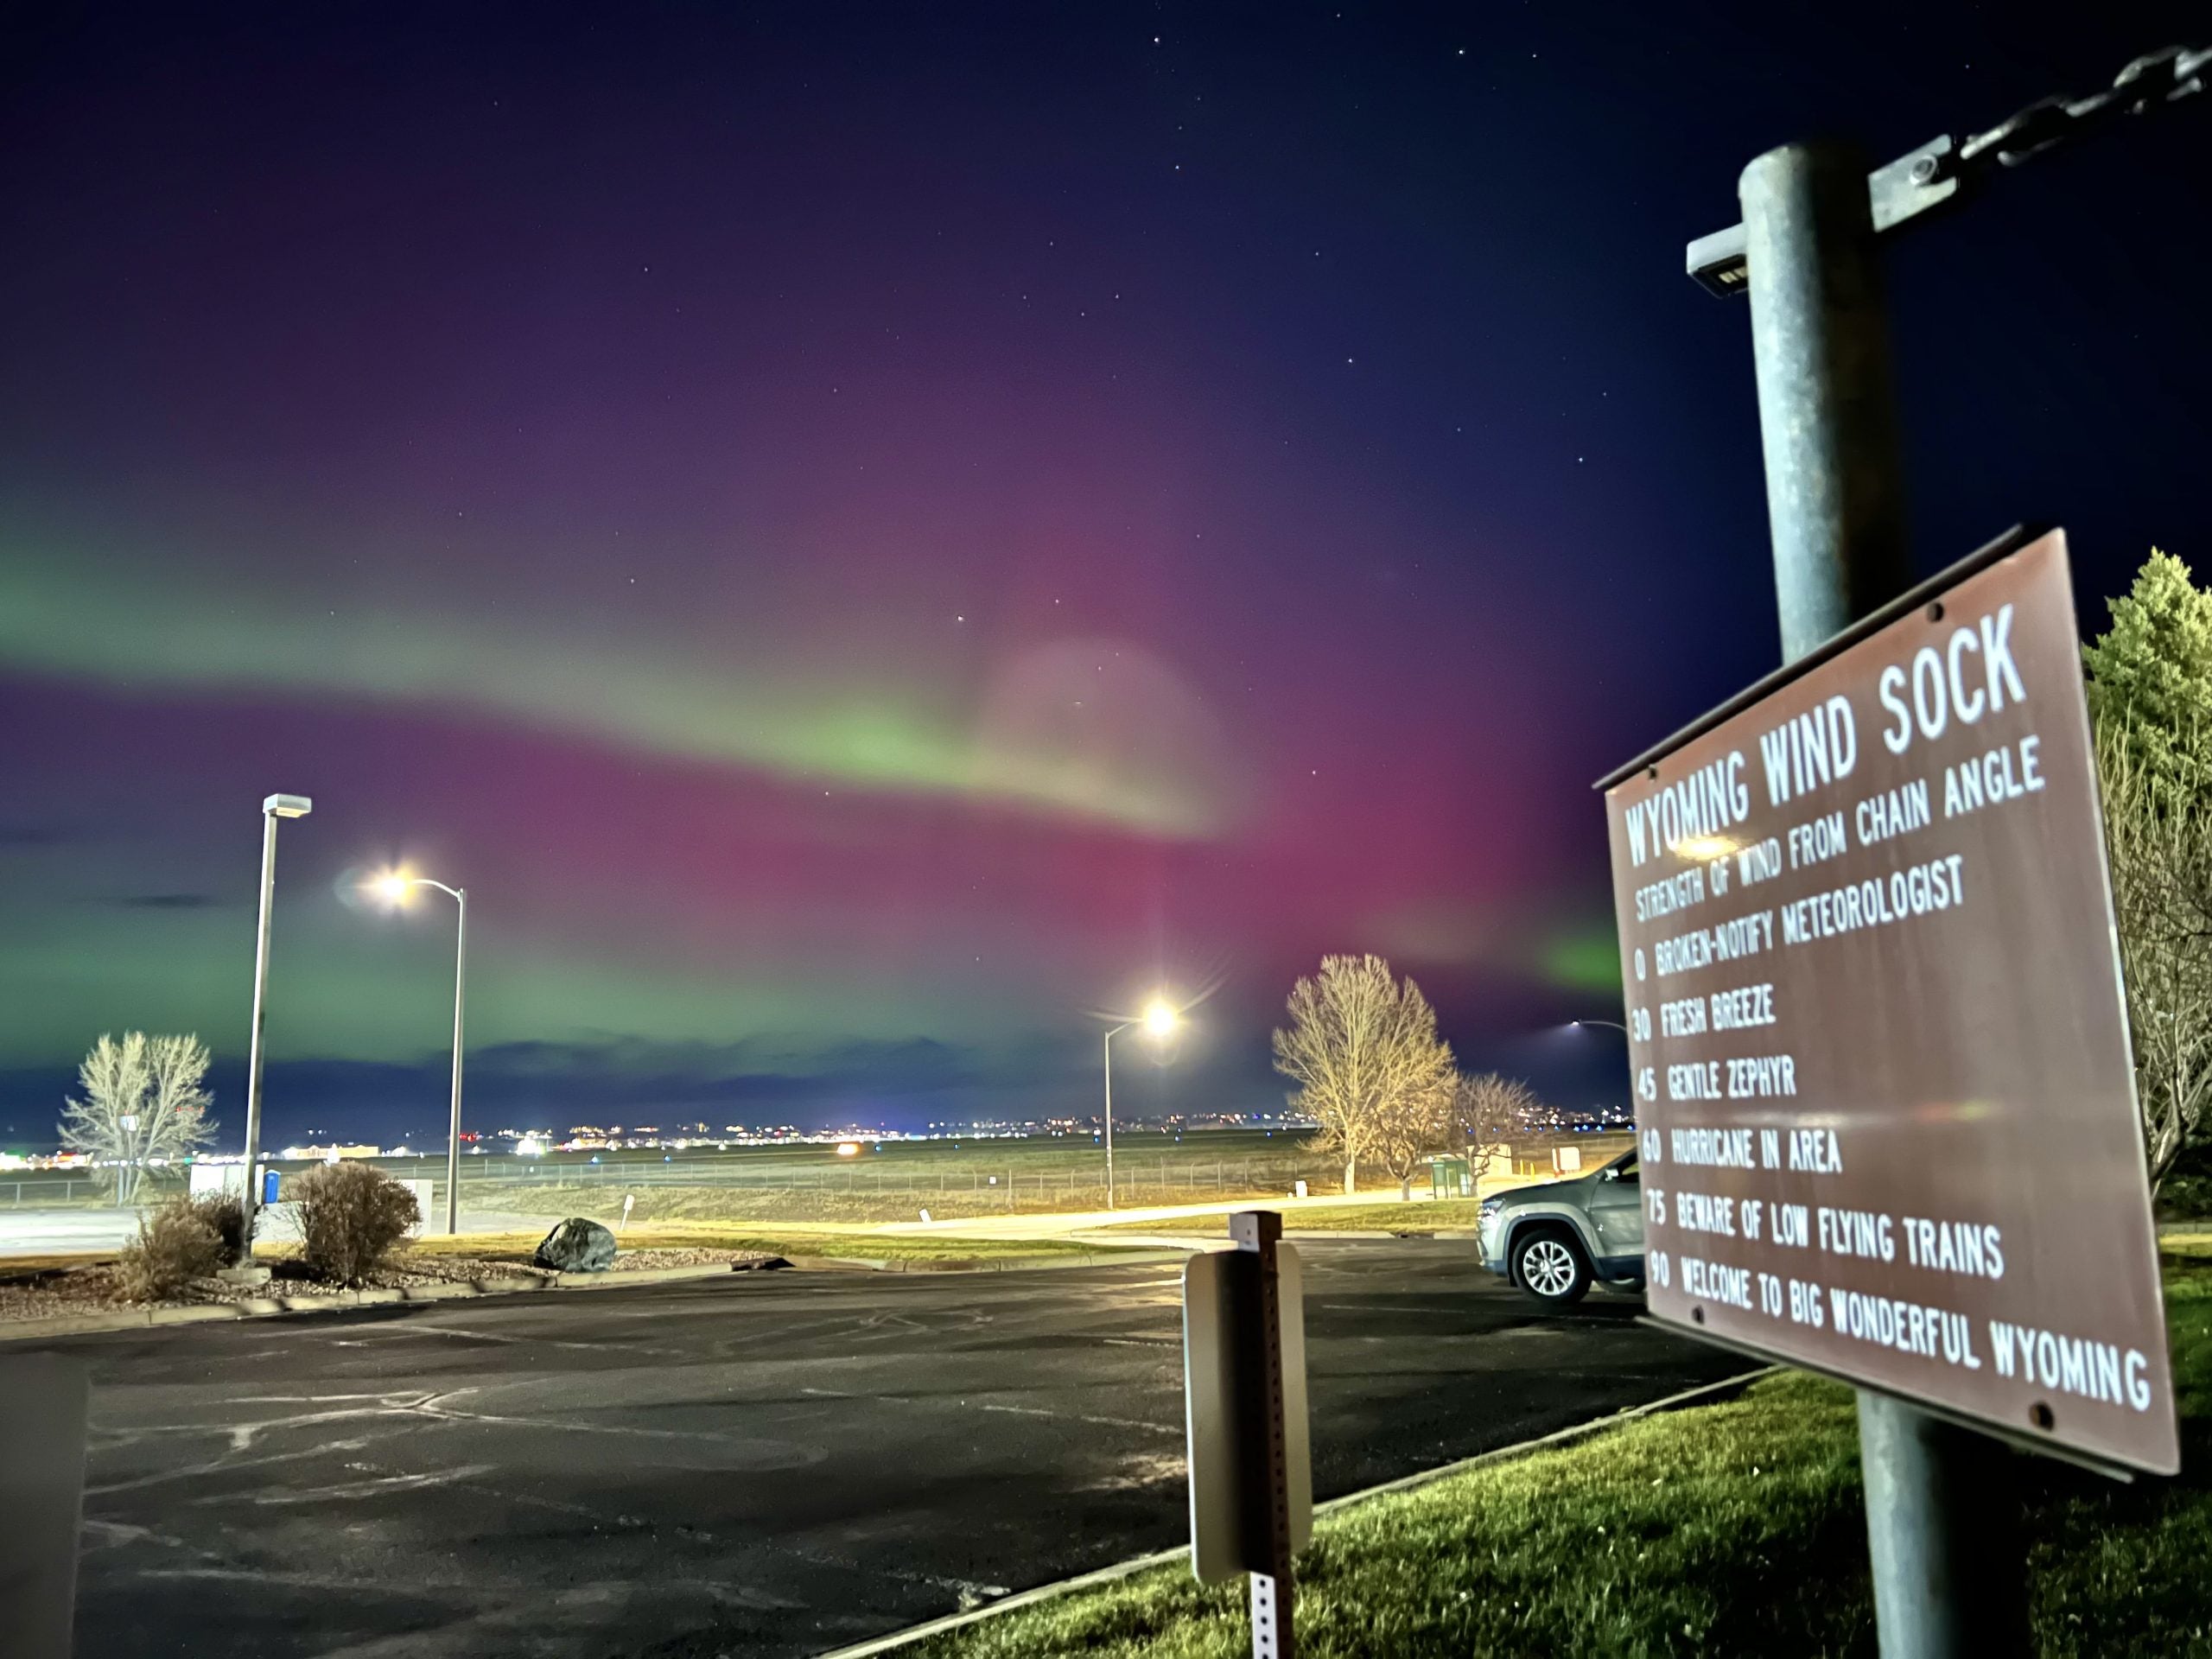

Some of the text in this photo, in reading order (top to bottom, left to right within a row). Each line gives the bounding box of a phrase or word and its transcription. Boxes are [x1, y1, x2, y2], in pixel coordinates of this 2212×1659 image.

[1625, 604, 2026, 867] WYOMING WIND SOCK
[1635, 735, 2045, 921] STRENGTH OF WIND FROM CHAIN ANGLE
[1635, 855, 1963, 981] 0 BROKEN-NOTIFY METEOROLOGIST
[1633, 983, 1776, 1041] 30 FRESH BREEZE
[1638, 1054, 1796, 1102] 45 GENTLE ZEPHYR
[1643, 1128, 1842, 1173] 60 HURRICANE IN AREA
[1647, 1189, 2005, 1280] 75 BEWARE OF LOW FLYING TRAINS
[1651, 1250, 2152, 1412] 90 WELCOME TO BIG WONDERFUL WYOMING
